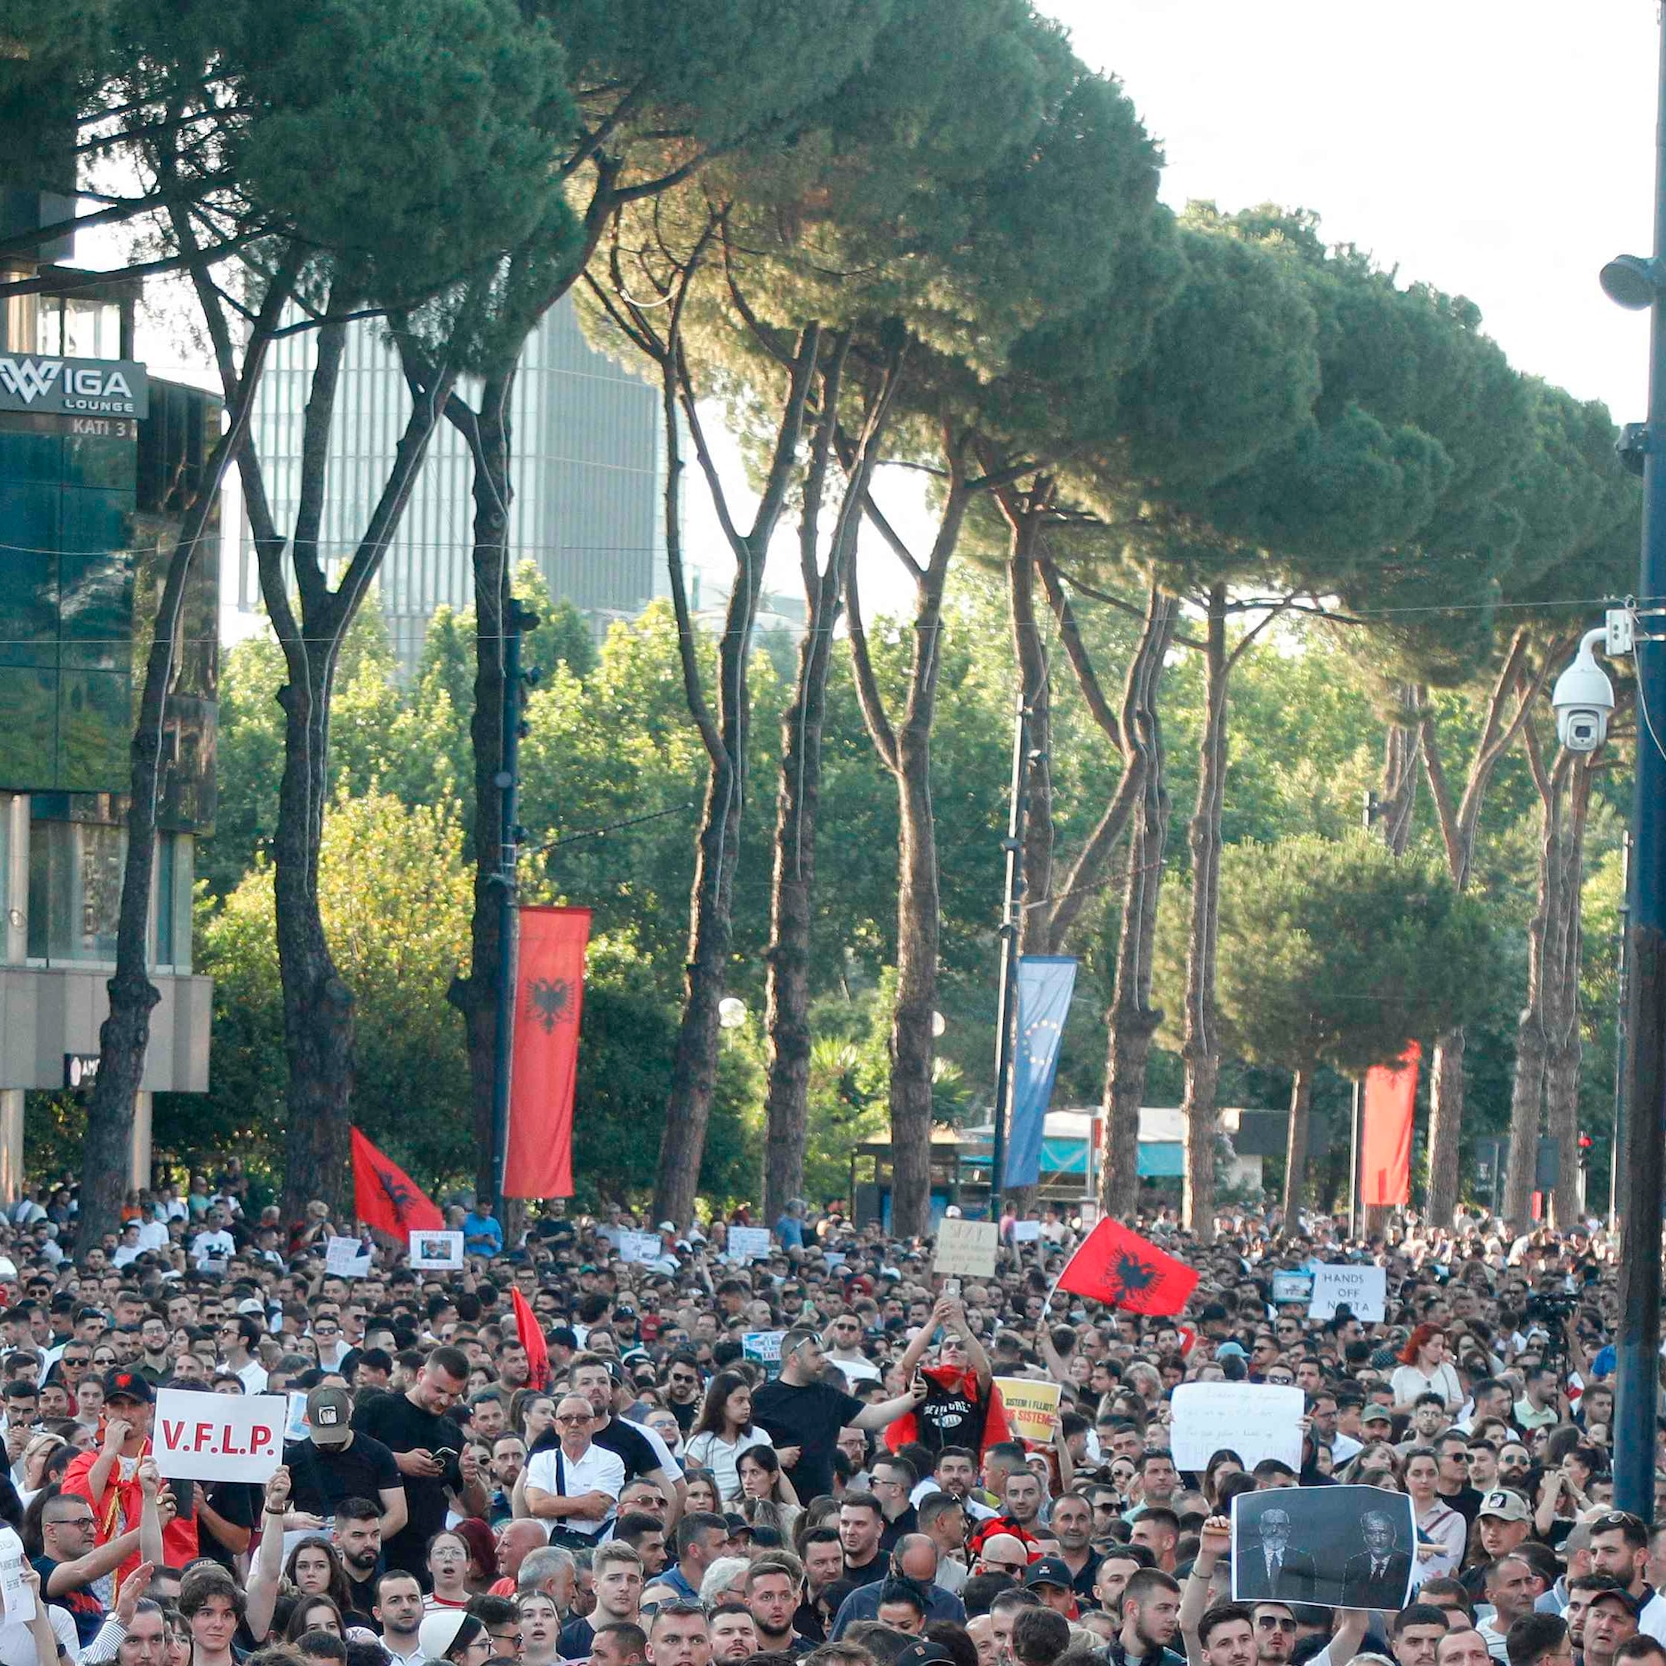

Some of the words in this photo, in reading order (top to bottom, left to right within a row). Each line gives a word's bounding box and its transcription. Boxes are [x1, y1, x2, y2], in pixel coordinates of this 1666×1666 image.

[65, 399, 134, 413] LOUNGE
[73, 419, 109, 436] KATI
[116, 423, 126, 437] 3
[1324, 1273, 1364, 1284] HANDS
[1338, 1288, 1360, 1298] OFF
[1327, 1300, 1370, 1312] NTA
[162, 1418, 275, 1457] V.F.L.P.
